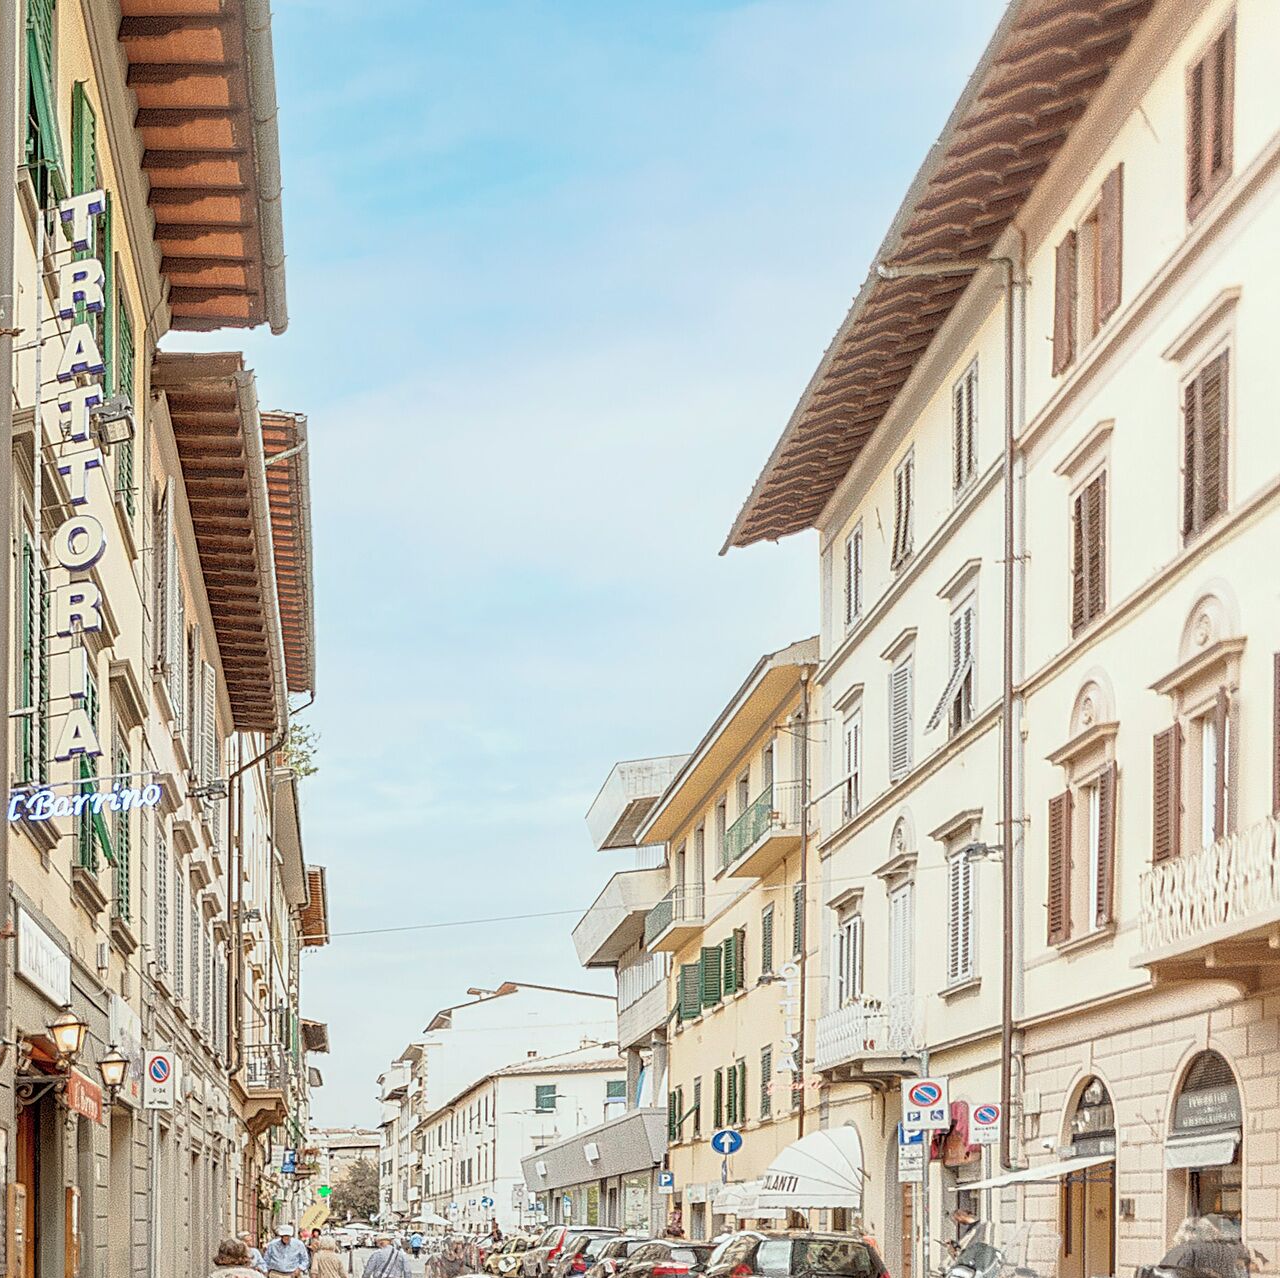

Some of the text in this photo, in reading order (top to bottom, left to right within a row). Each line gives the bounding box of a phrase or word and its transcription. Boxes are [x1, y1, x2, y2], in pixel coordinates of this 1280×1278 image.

[52, 188, 108, 764] TRATTORIA
[25, 783, 162, 821] Barrino
[661, 1174, 671, 1186] P
